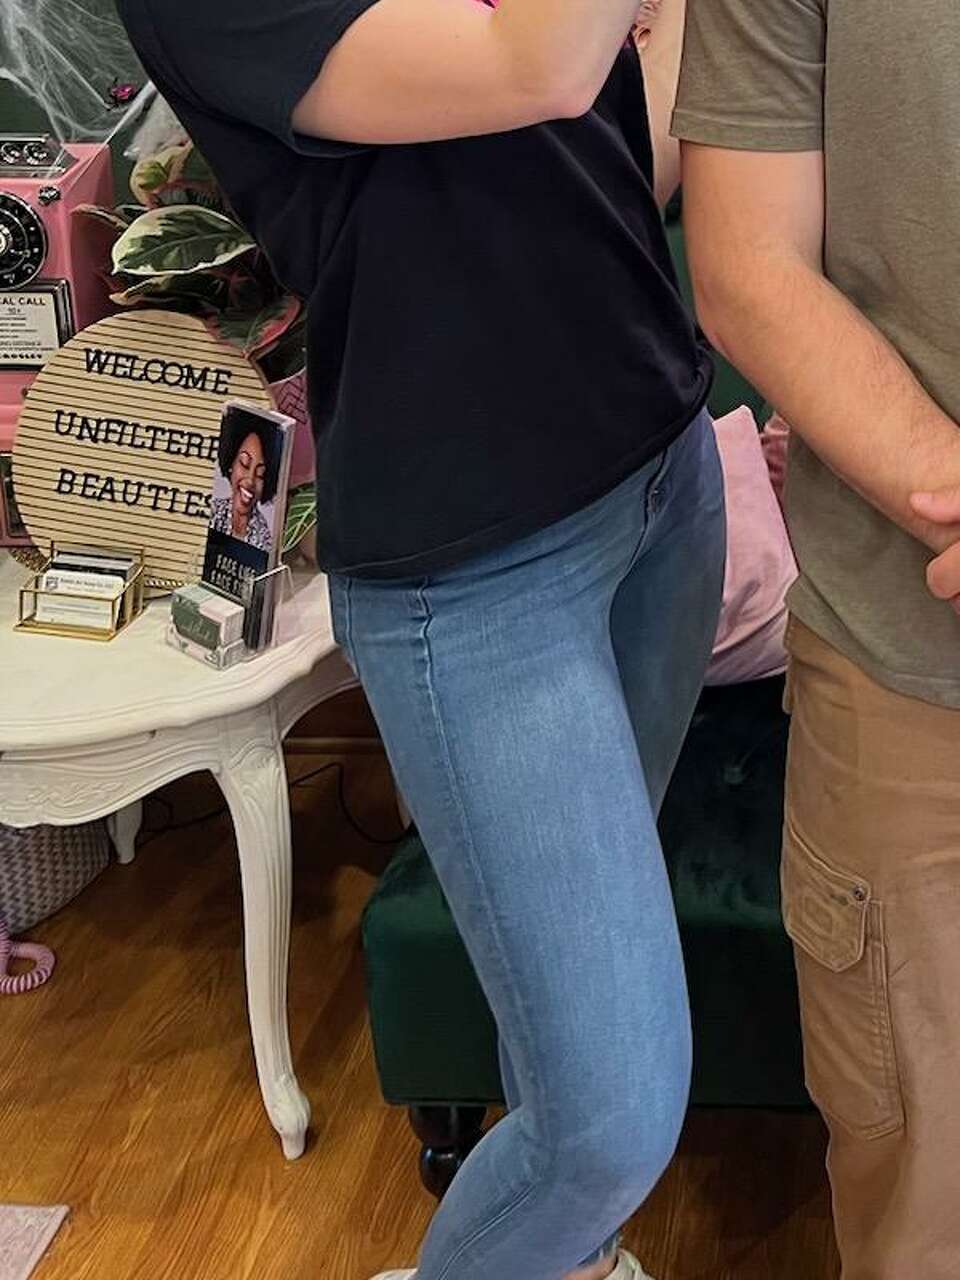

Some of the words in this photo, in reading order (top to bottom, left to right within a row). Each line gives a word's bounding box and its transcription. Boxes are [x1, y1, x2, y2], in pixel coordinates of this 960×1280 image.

[0, 297, 15, 306] AL
[18, 297, 46, 306] CALL
[83, 348, 232, 394] WELCOME
[54, 409, 221, 463] UNFILTERE
